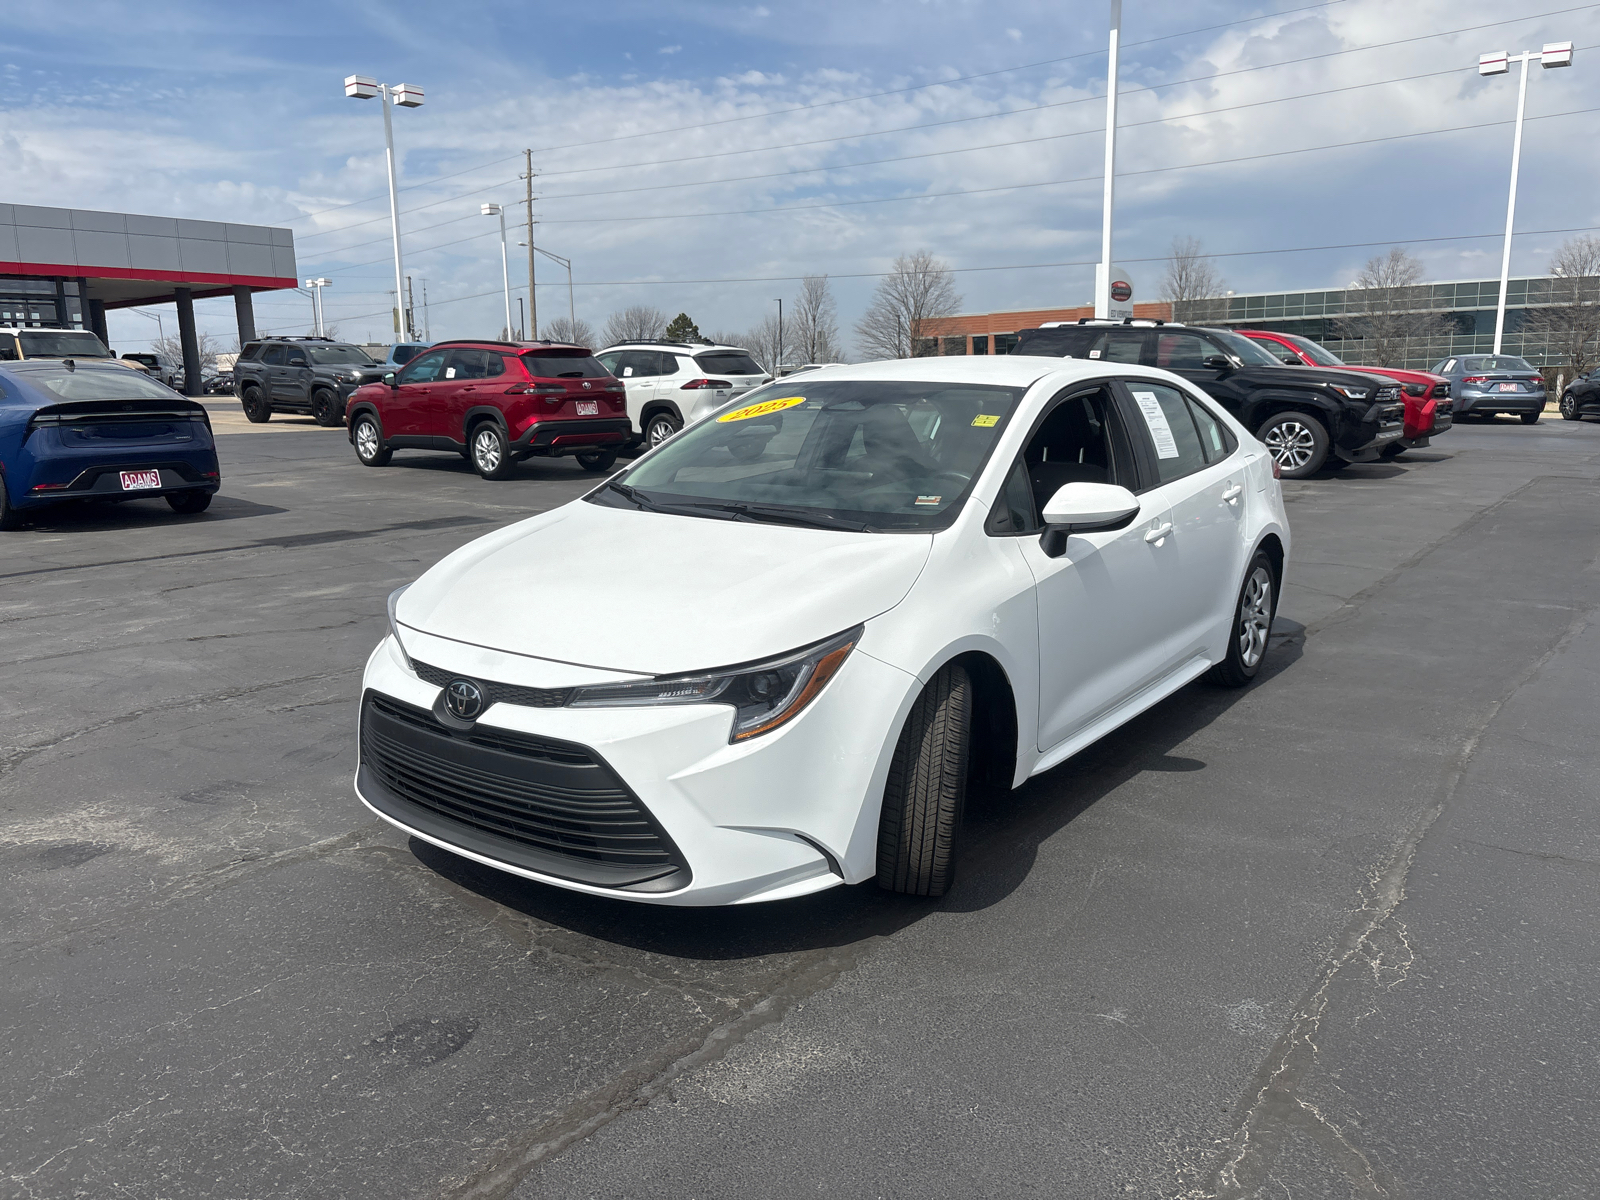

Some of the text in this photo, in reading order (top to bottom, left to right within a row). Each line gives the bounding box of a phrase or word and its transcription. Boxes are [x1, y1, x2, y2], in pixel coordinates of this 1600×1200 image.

[577, 403, 596, 413] ADAMS
[729, 399, 792, 420] 2025
[124, 473, 157, 488] ADAMS
